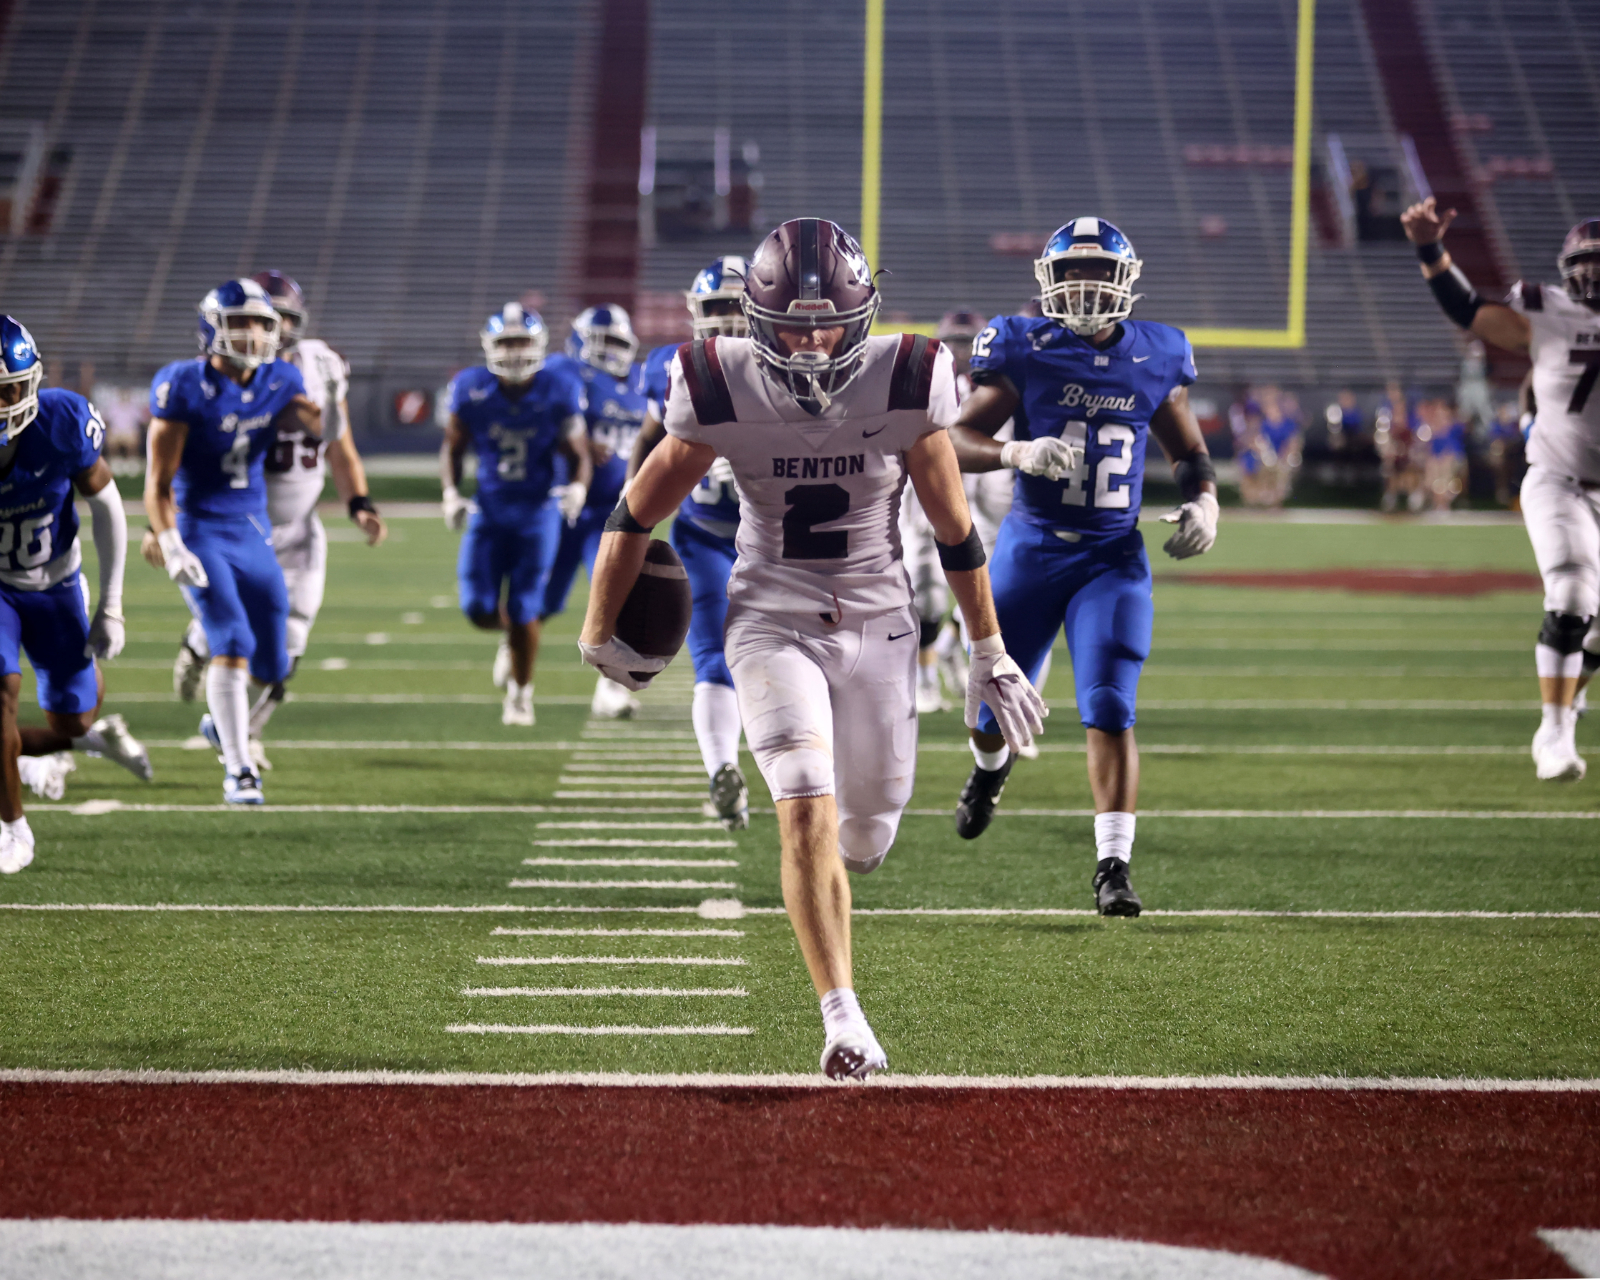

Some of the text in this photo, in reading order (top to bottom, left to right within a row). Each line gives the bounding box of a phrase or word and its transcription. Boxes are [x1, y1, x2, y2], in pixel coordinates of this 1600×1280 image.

[794, 302, 829, 311] Riddell
[1057, 383, 1136, 417] Bryant
[221, 434, 250, 489] 4
[772, 454, 865, 479] BENTON
[1056, 420, 1136, 508] 42
[782, 483, 850, 560] 2
